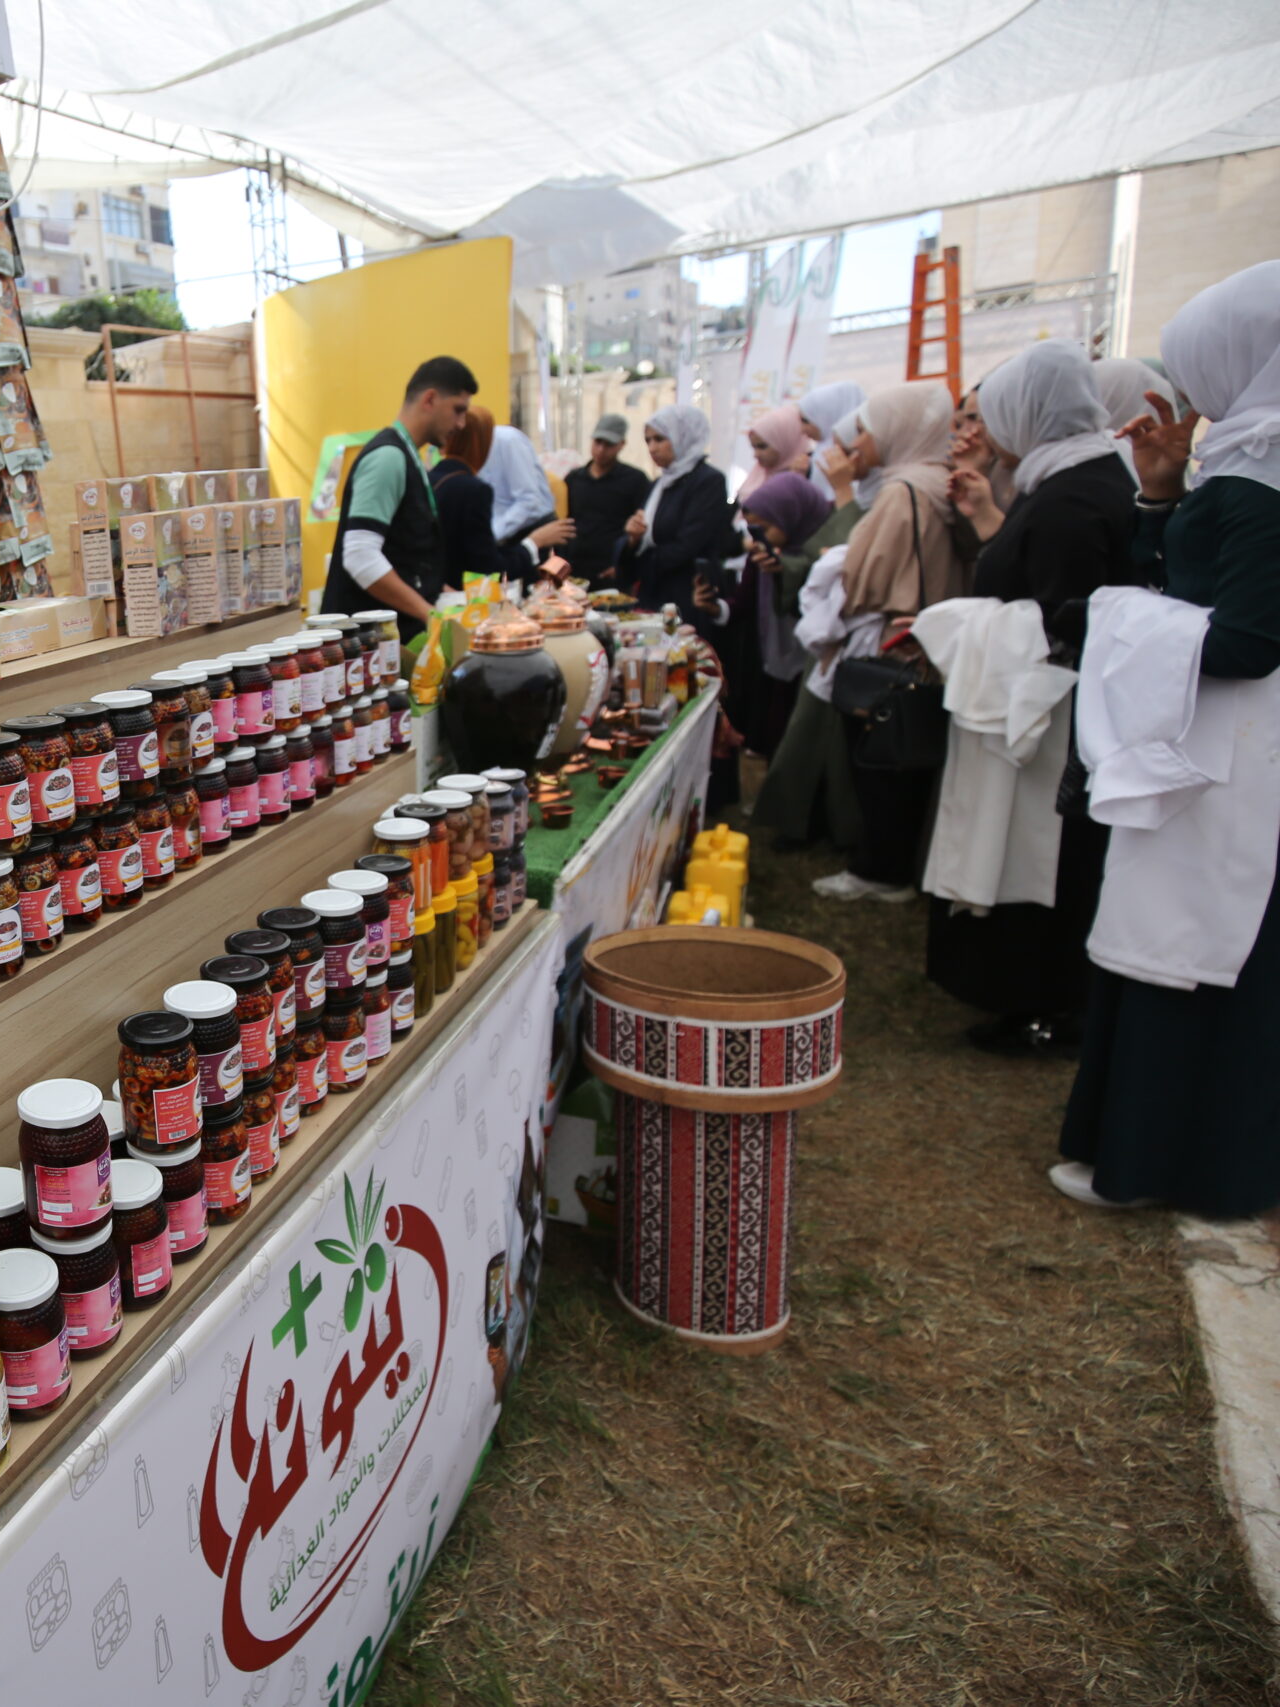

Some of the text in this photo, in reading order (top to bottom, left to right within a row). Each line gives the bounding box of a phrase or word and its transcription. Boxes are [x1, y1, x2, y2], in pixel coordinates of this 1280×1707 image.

[267, 1370, 429, 1613] للمخللات والمواد الغذائية
